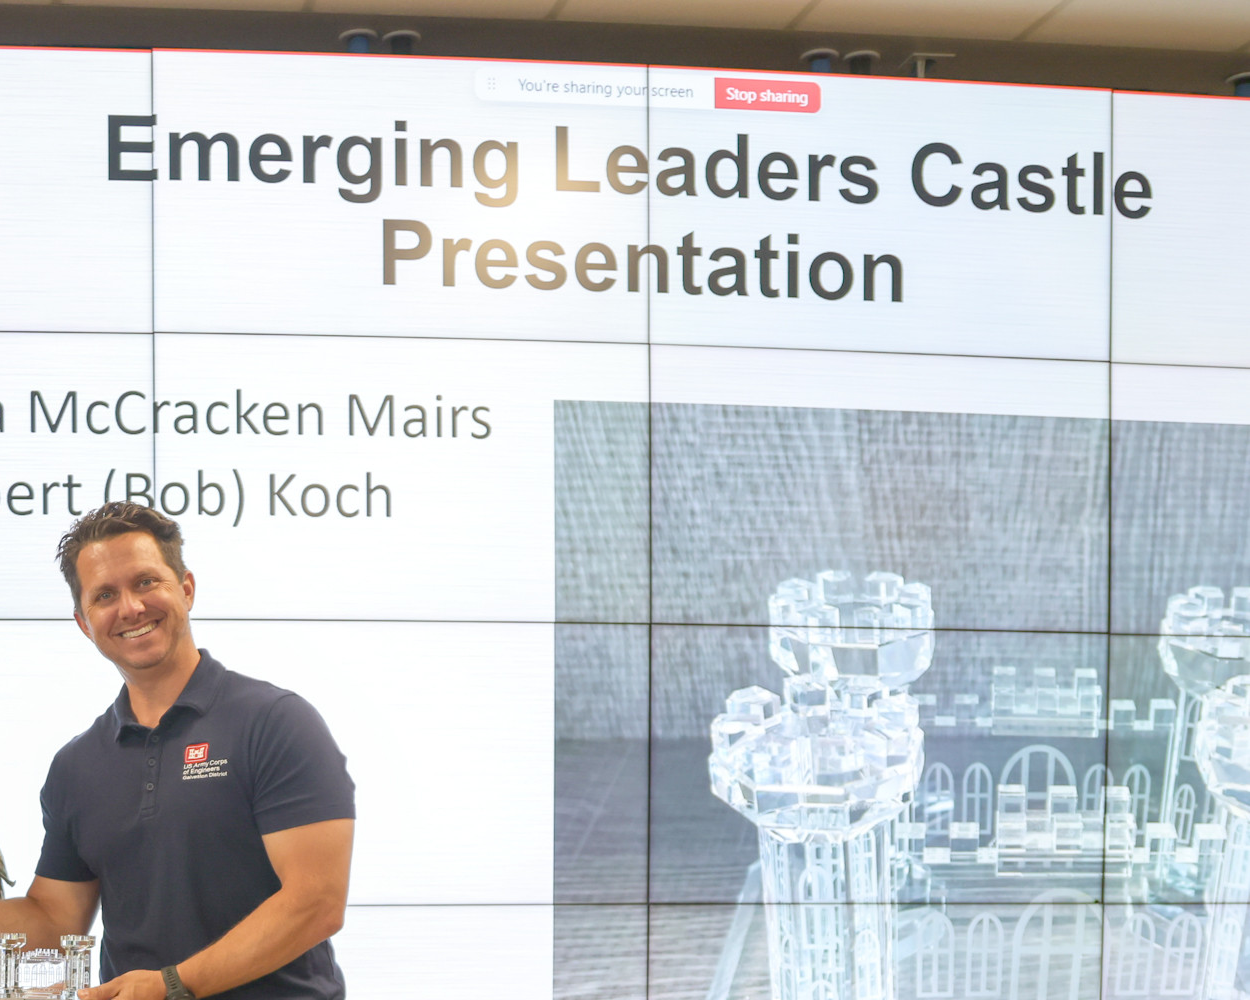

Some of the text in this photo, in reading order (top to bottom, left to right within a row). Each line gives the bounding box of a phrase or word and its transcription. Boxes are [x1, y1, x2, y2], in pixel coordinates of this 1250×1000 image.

[518, 77, 694, 99] You're sharing your screen
[726, 86, 809, 107] Stop sharing
[107, 114, 1154, 219] Emerging Leaders Castle
[382, 218, 904, 303] Presentation
[30, 388, 324, 436] McCracken
[348, 393, 493, 440] Mairs
[269, 472, 393, 518] Koch
[190, 766, 220, 775] Engineers
